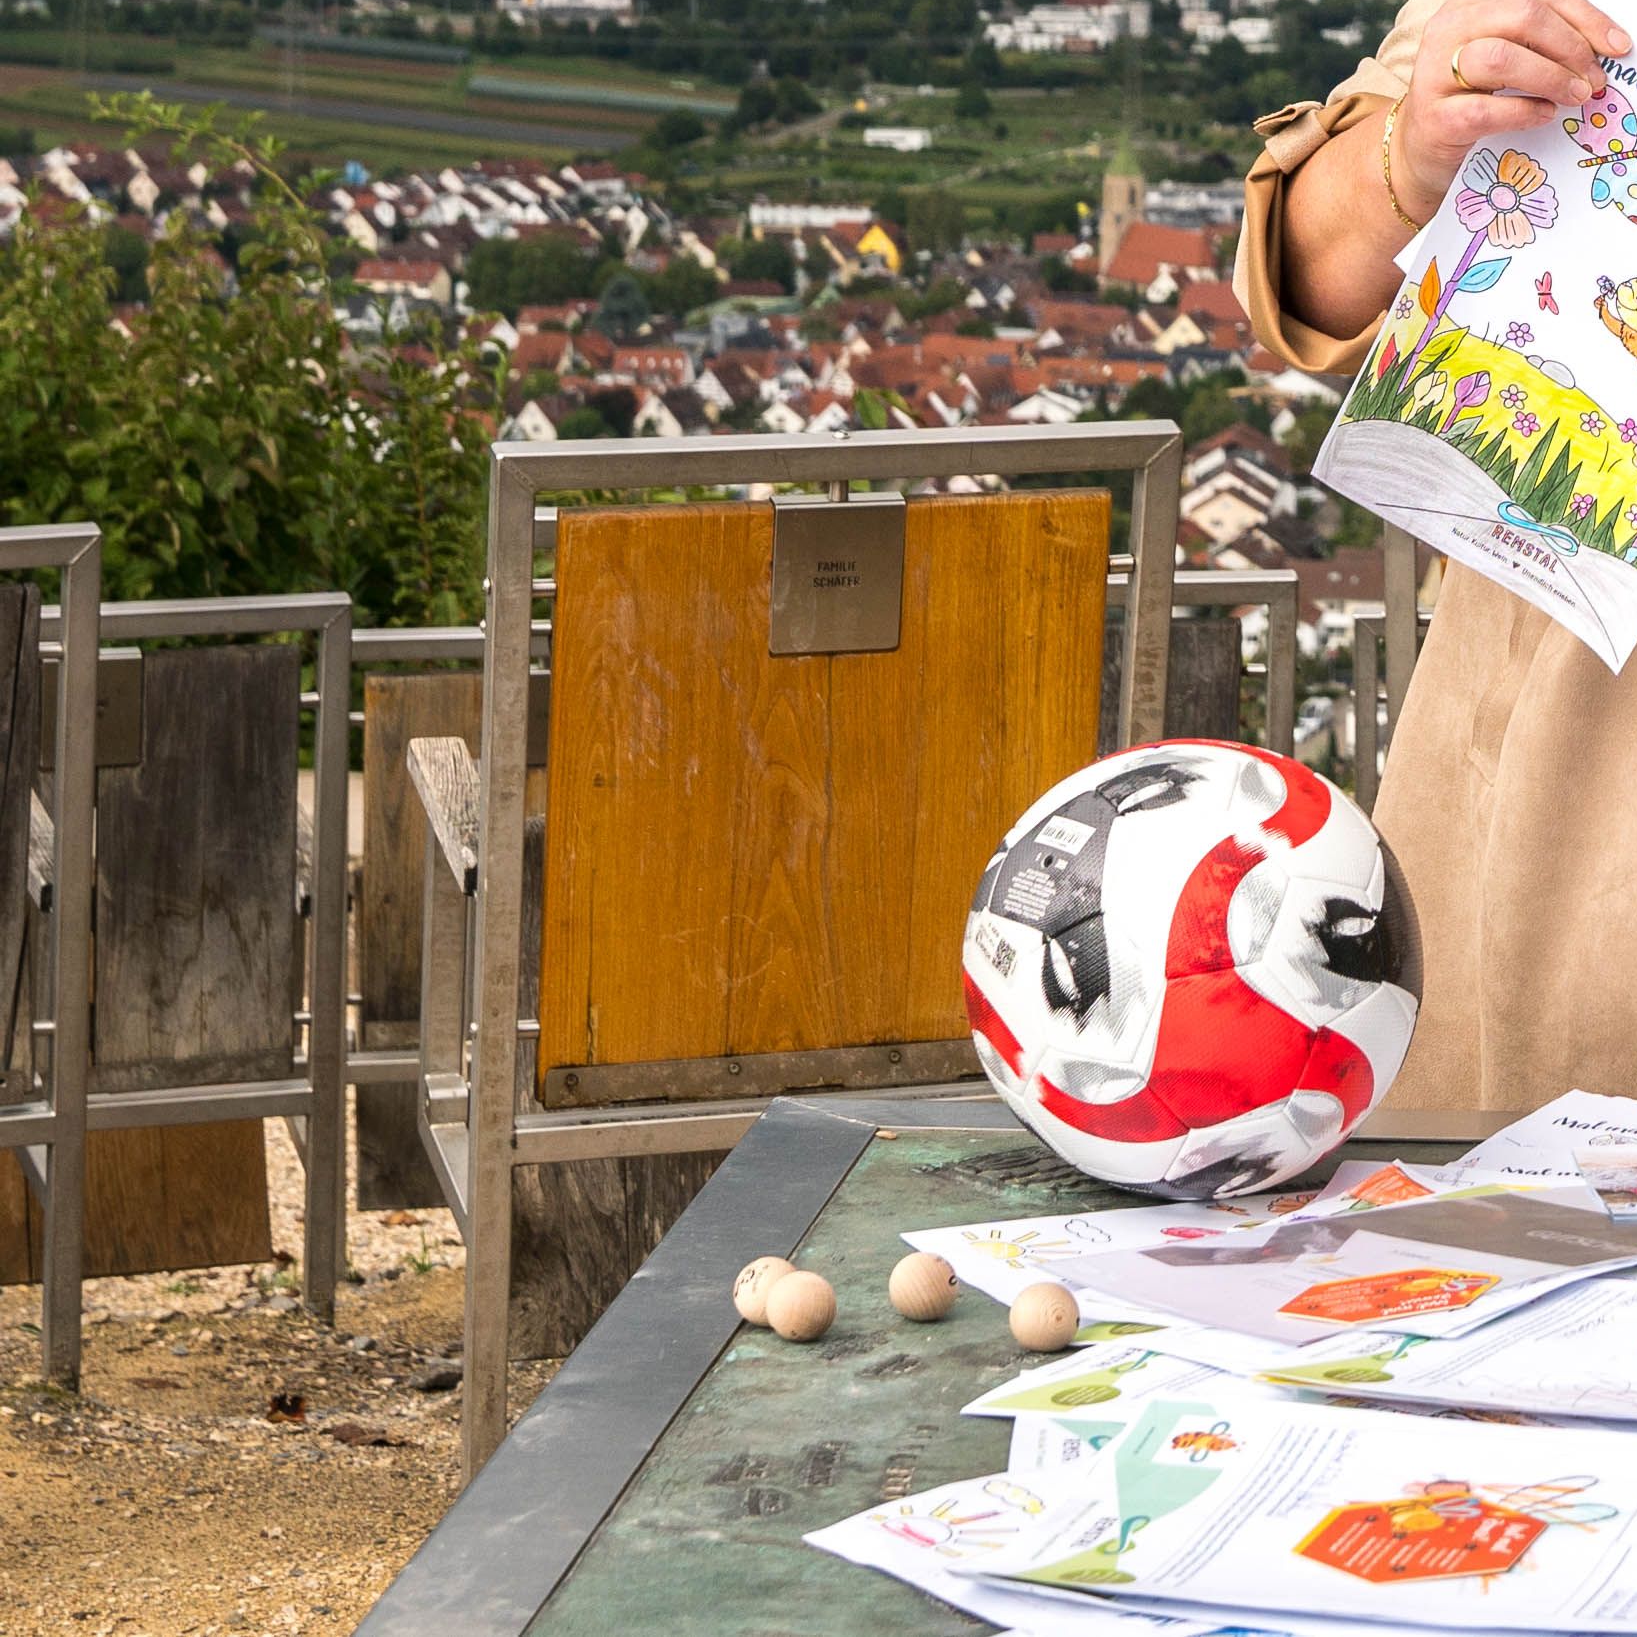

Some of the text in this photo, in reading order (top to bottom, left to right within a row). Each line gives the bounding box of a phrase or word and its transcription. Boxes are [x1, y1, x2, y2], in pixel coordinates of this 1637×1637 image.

[1491, 524, 1559, 574] REMSTAL
[817, 562, 857, 572] FAMILIE
[1553, 1116, 1607, 1131] Mal
